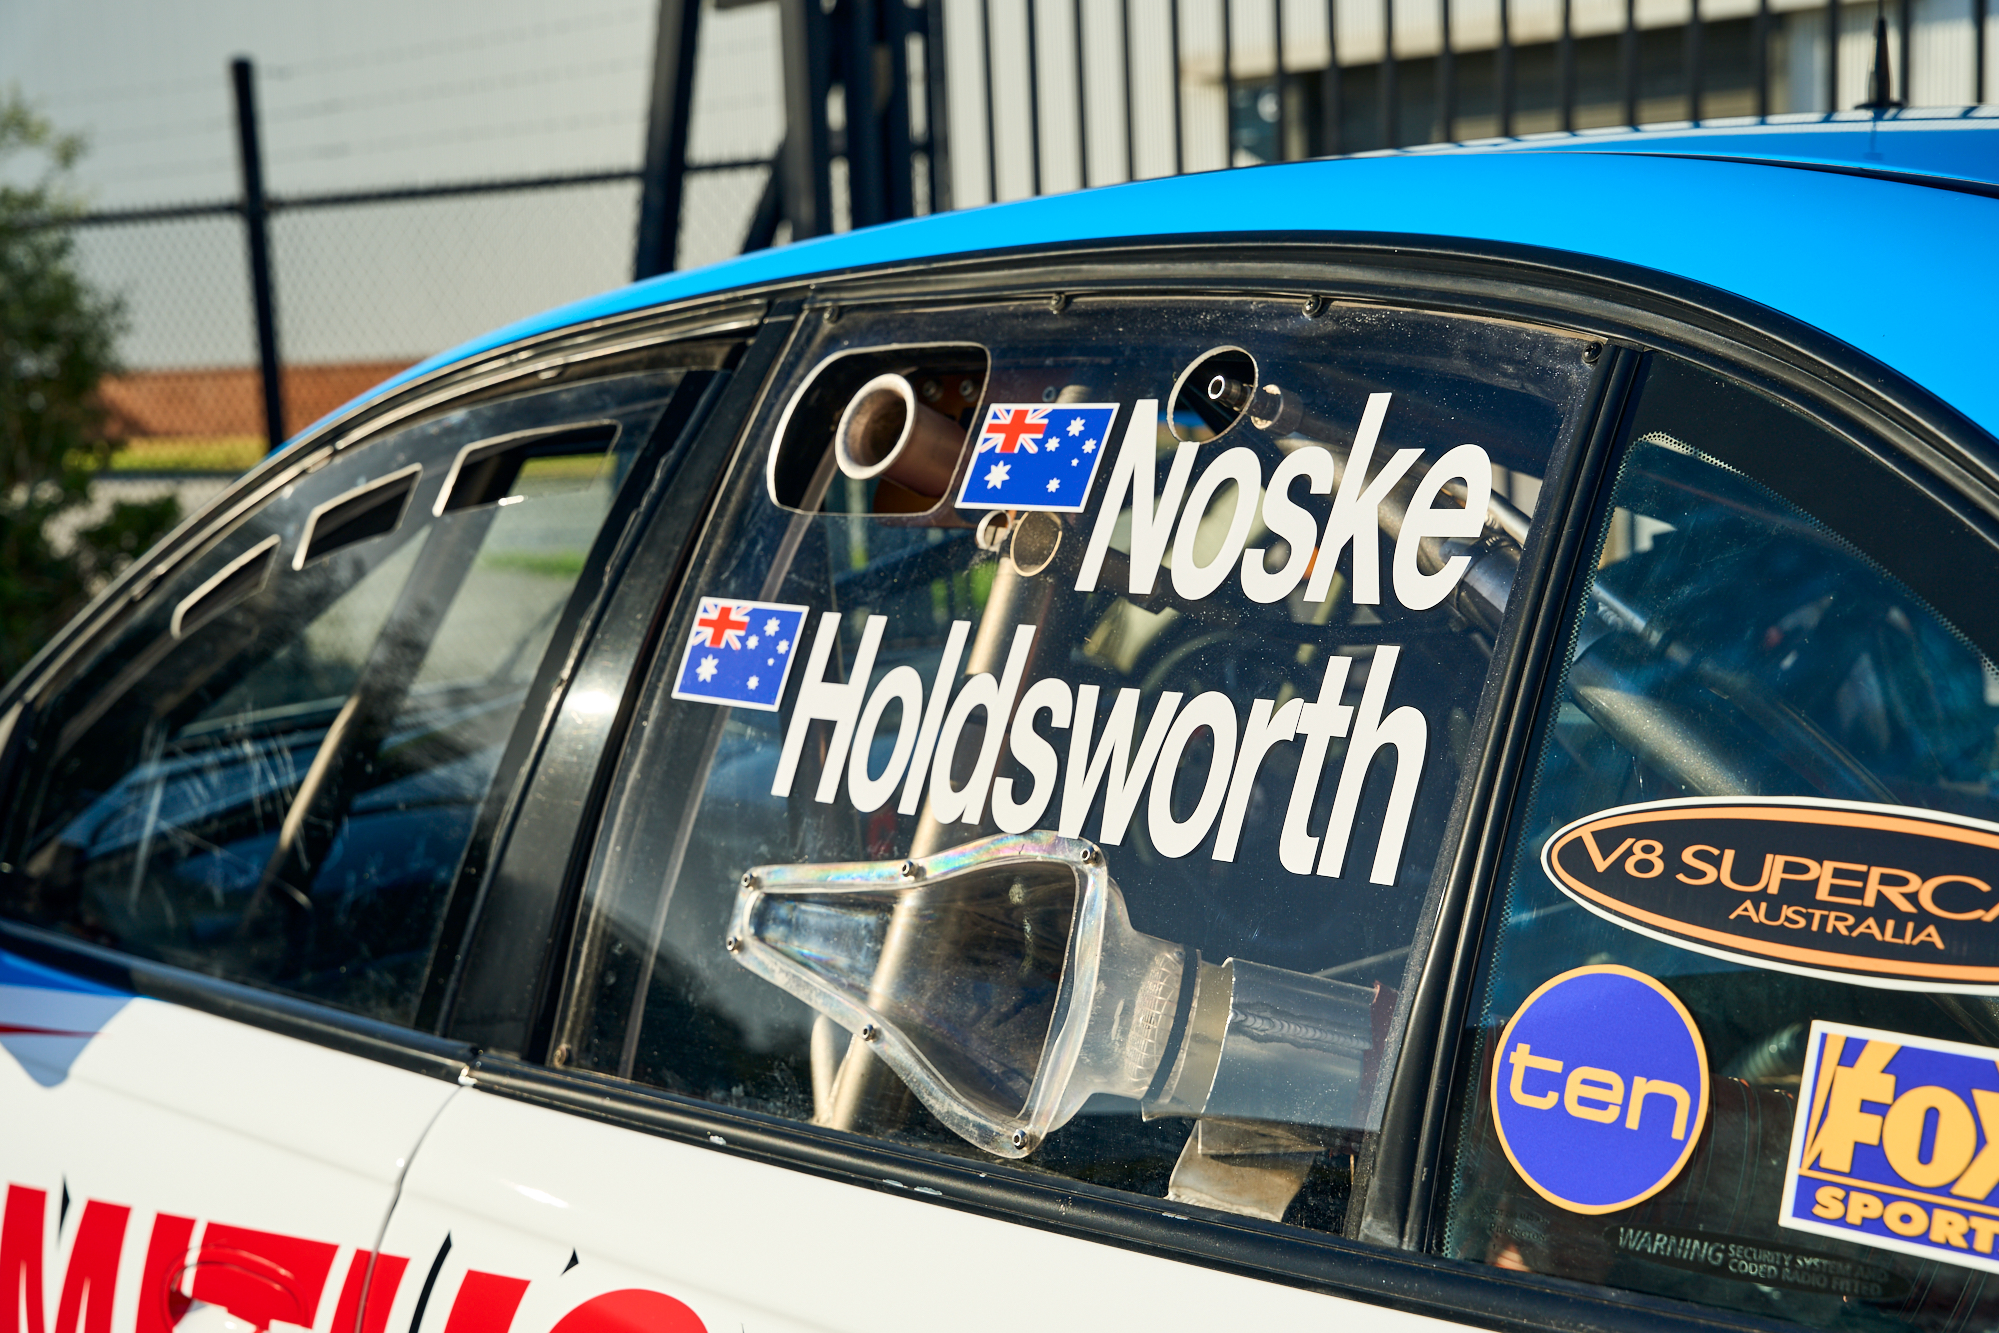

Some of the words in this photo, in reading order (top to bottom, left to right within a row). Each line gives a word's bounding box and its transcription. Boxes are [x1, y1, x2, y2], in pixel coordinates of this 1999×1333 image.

[1074, 392, 1492, 610] Noske
[771, 611, 1427, 887] Holdsworth
[1580, 831, 1665, 879] V8
[1675, 844, 1999, 922] SUPERC
[1728, 899, 1945, 950] AUSTRALIA
[1508, 1042, 1691, 1141] ten
[1618, 1226, 1726, 1267] WARNING
[1728, 1244, 1793, 1267] SECURITY
[1795, 1254, 1851, 1277] SYSTEM
[1853, 1263, 1889, 1283] AND
[1728, 1258, 1778, 1279] CODED
[1781, 1267, 1828, 1289] RADIO
[1831, 1276, 1883, 1297] FITTED
